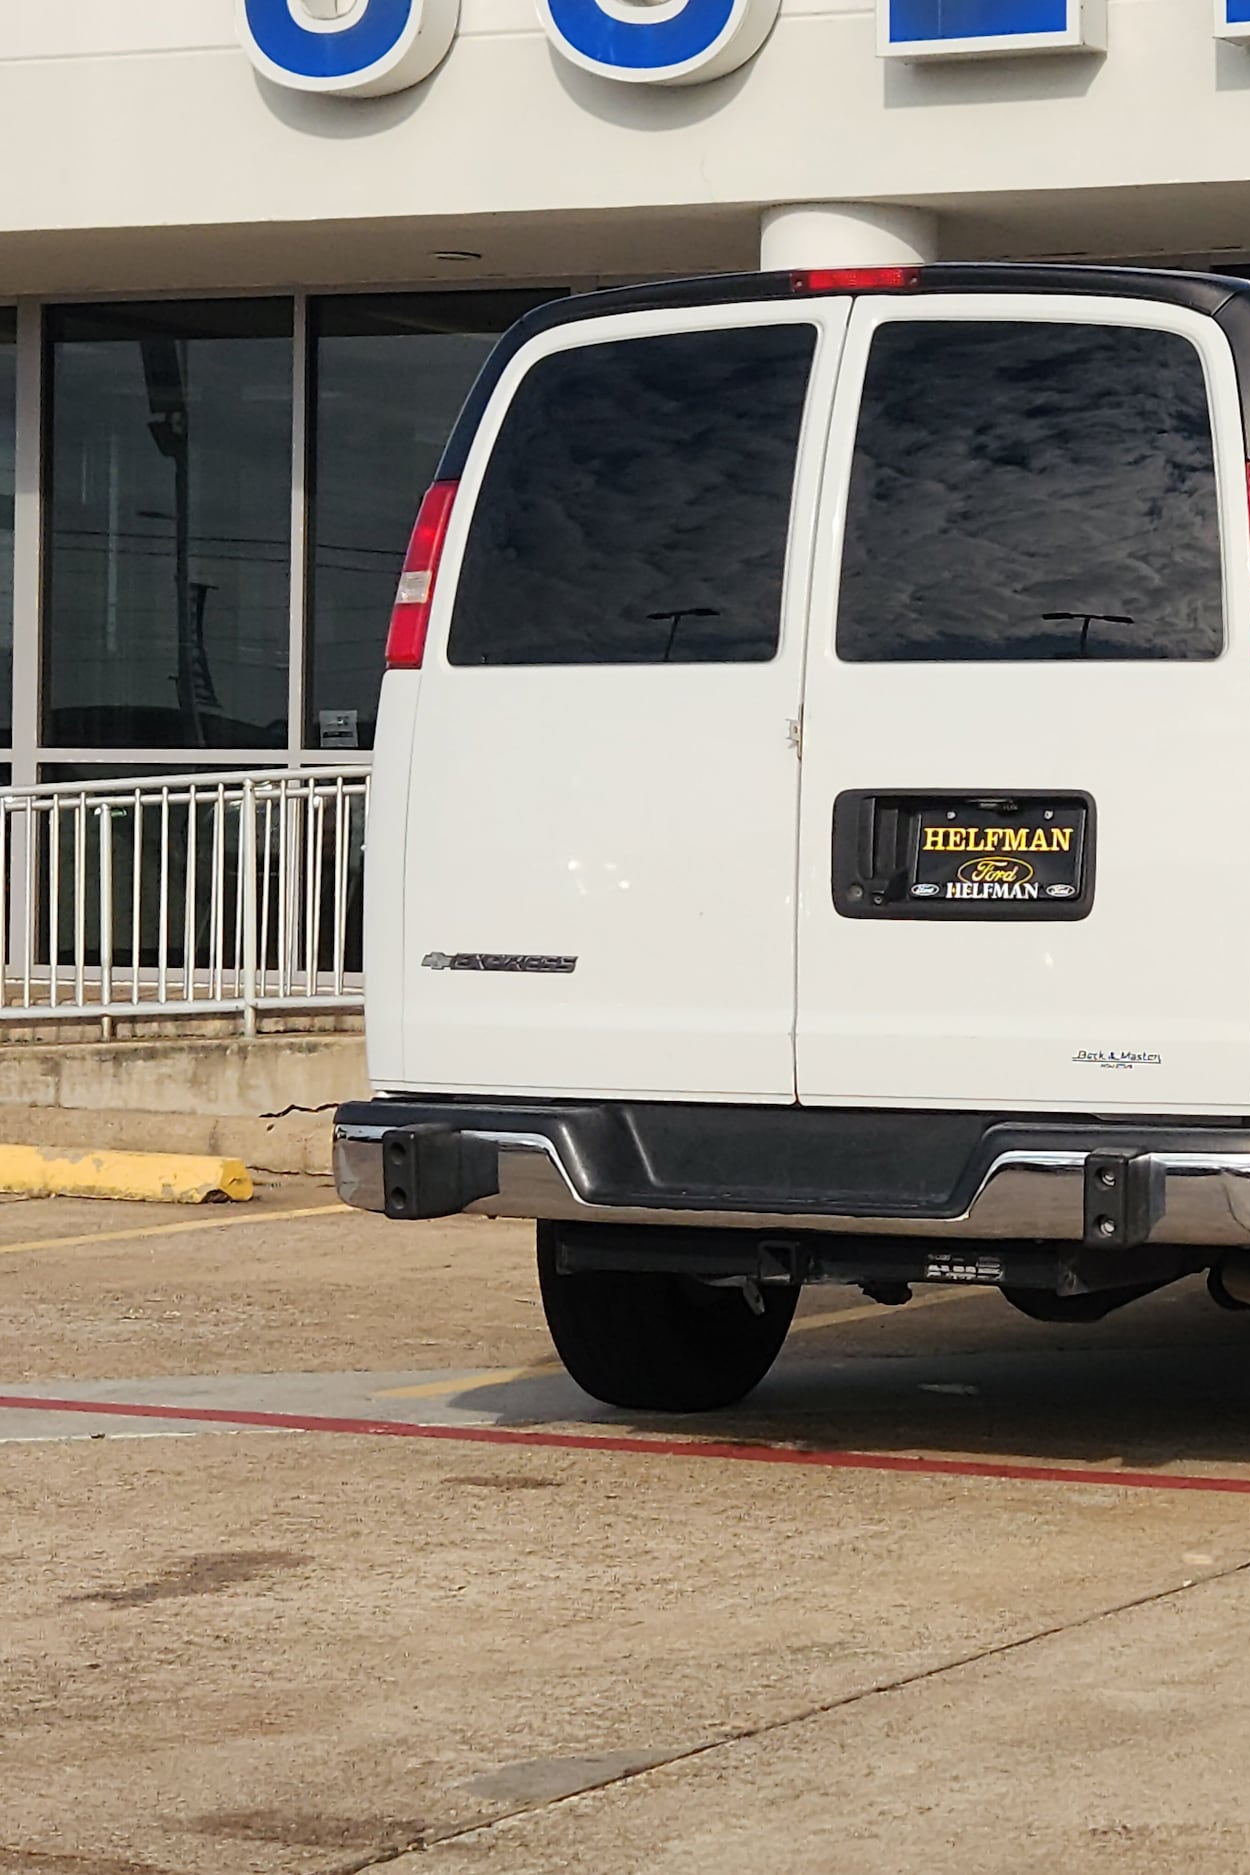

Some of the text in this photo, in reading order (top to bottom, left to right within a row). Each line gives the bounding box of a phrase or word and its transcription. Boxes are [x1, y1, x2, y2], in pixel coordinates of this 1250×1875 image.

[922, 827, 1074, 851] HELFMAN
[972, 860, 1019, 882] Ford
[945, 882, 1039, 899] HELFMAN
